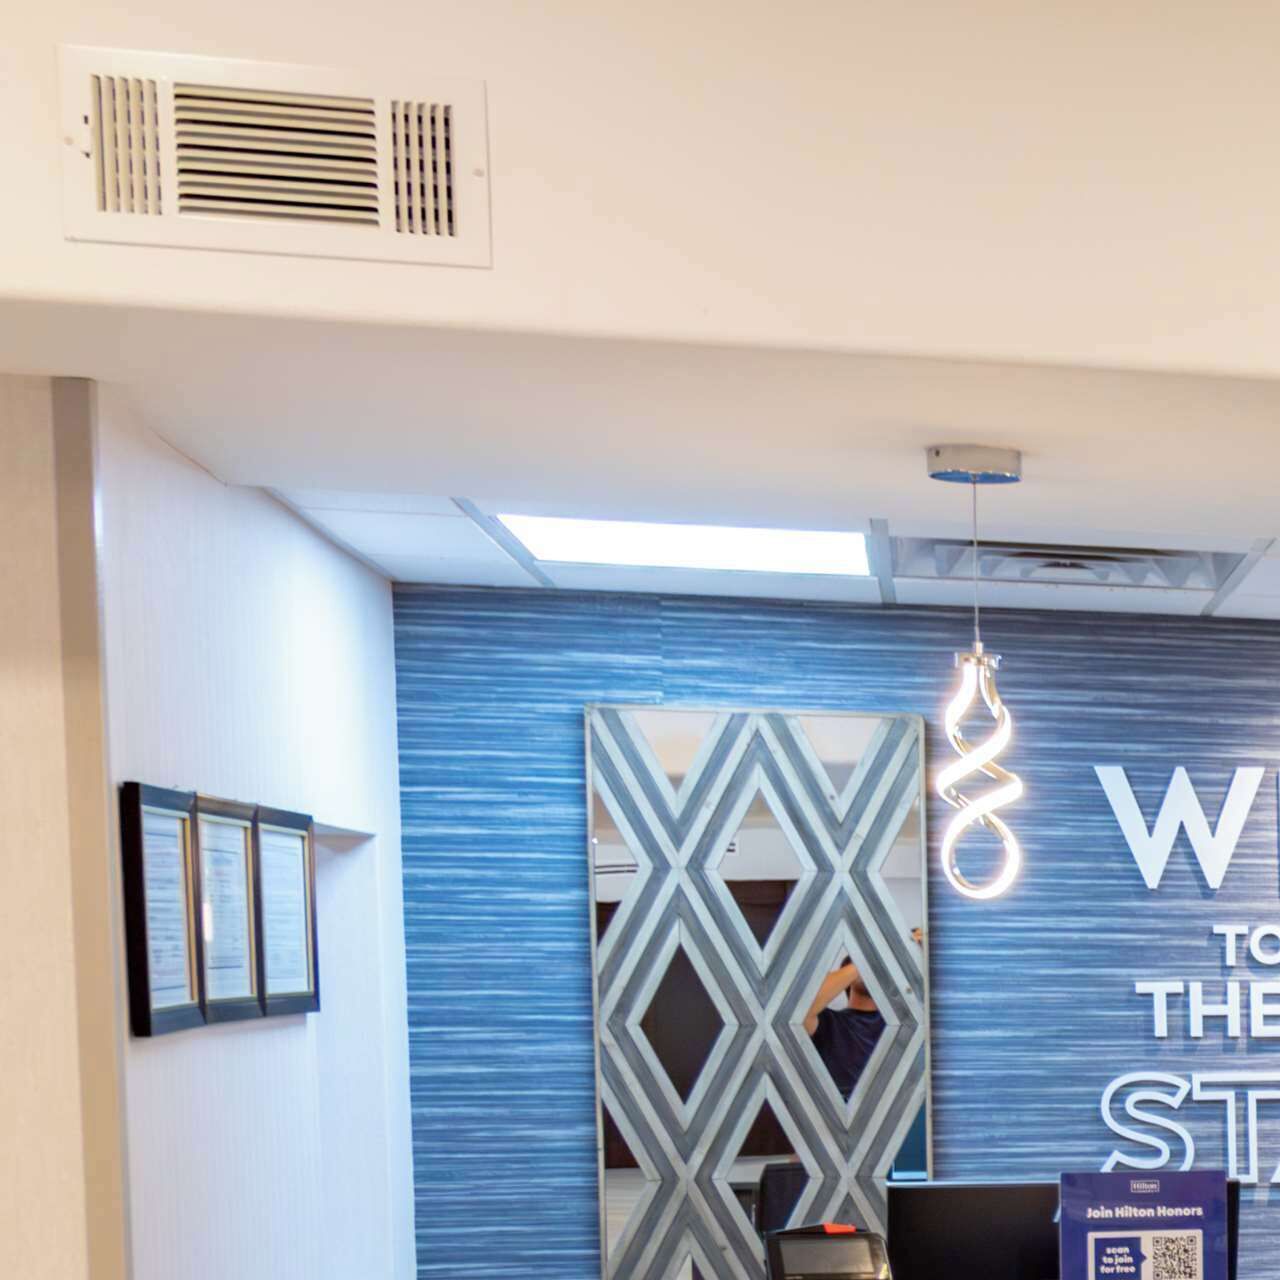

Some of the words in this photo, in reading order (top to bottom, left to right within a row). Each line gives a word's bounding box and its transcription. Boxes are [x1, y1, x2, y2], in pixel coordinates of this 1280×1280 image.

[1133, 1182, 1157, 1190] Hilton
[1087, 1205, 1113, 1218] Join
[1115, 1205, 1155, 1218] Hilton
[1157, 1206, 1203, 1217] Honors
[1102, 1255, 1113, 1264] to
[1114, 1255, 1133, 1265] join
[1100, 1265, 1115, 1273] for
[1116, 1265, 1136, 1273] free
